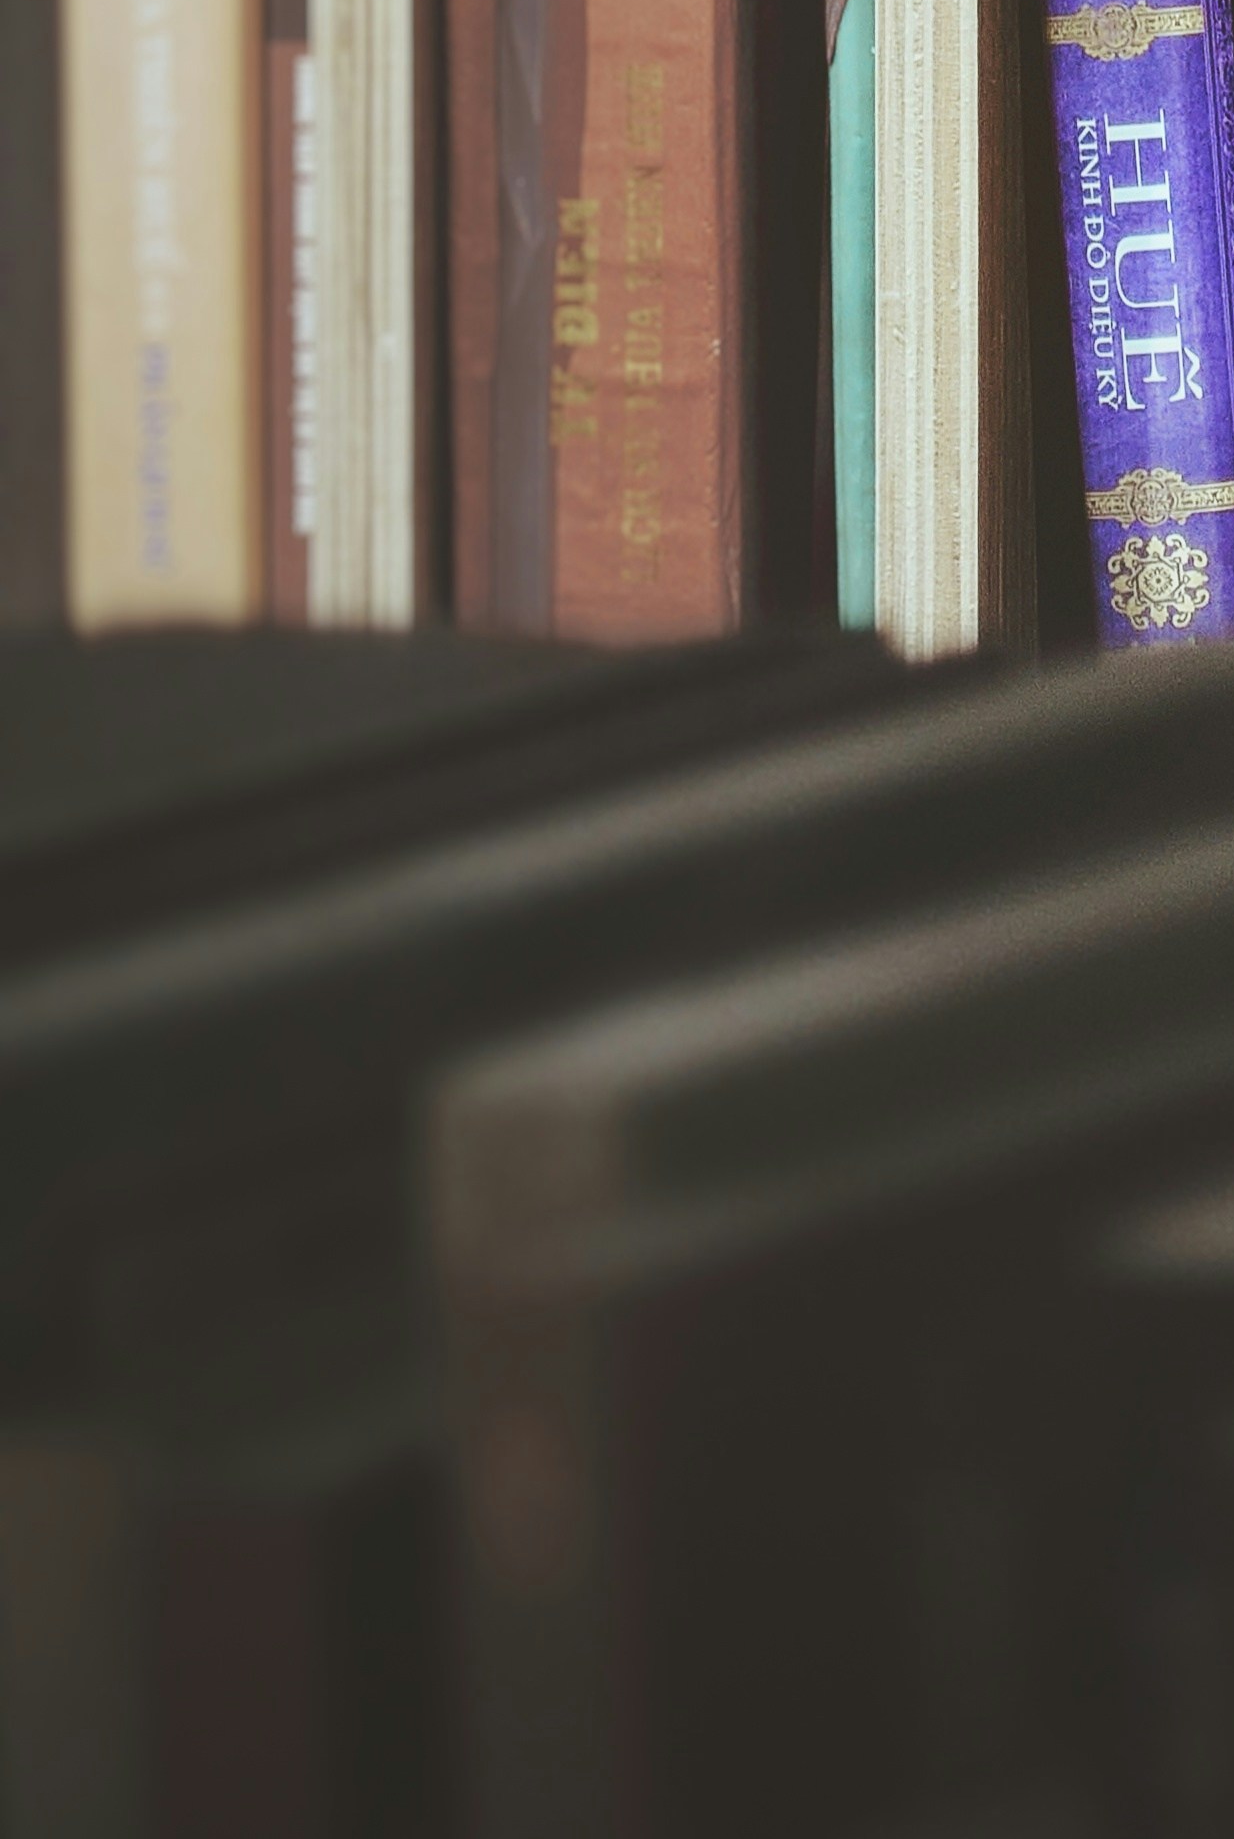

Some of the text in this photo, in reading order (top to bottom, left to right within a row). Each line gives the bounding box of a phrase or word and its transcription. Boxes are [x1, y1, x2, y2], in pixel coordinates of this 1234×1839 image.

[1077, 117, 1122, 410] KINH ĐÔ DIỆU KỲ
[1104, 108, 1203, 410] HUẾ
